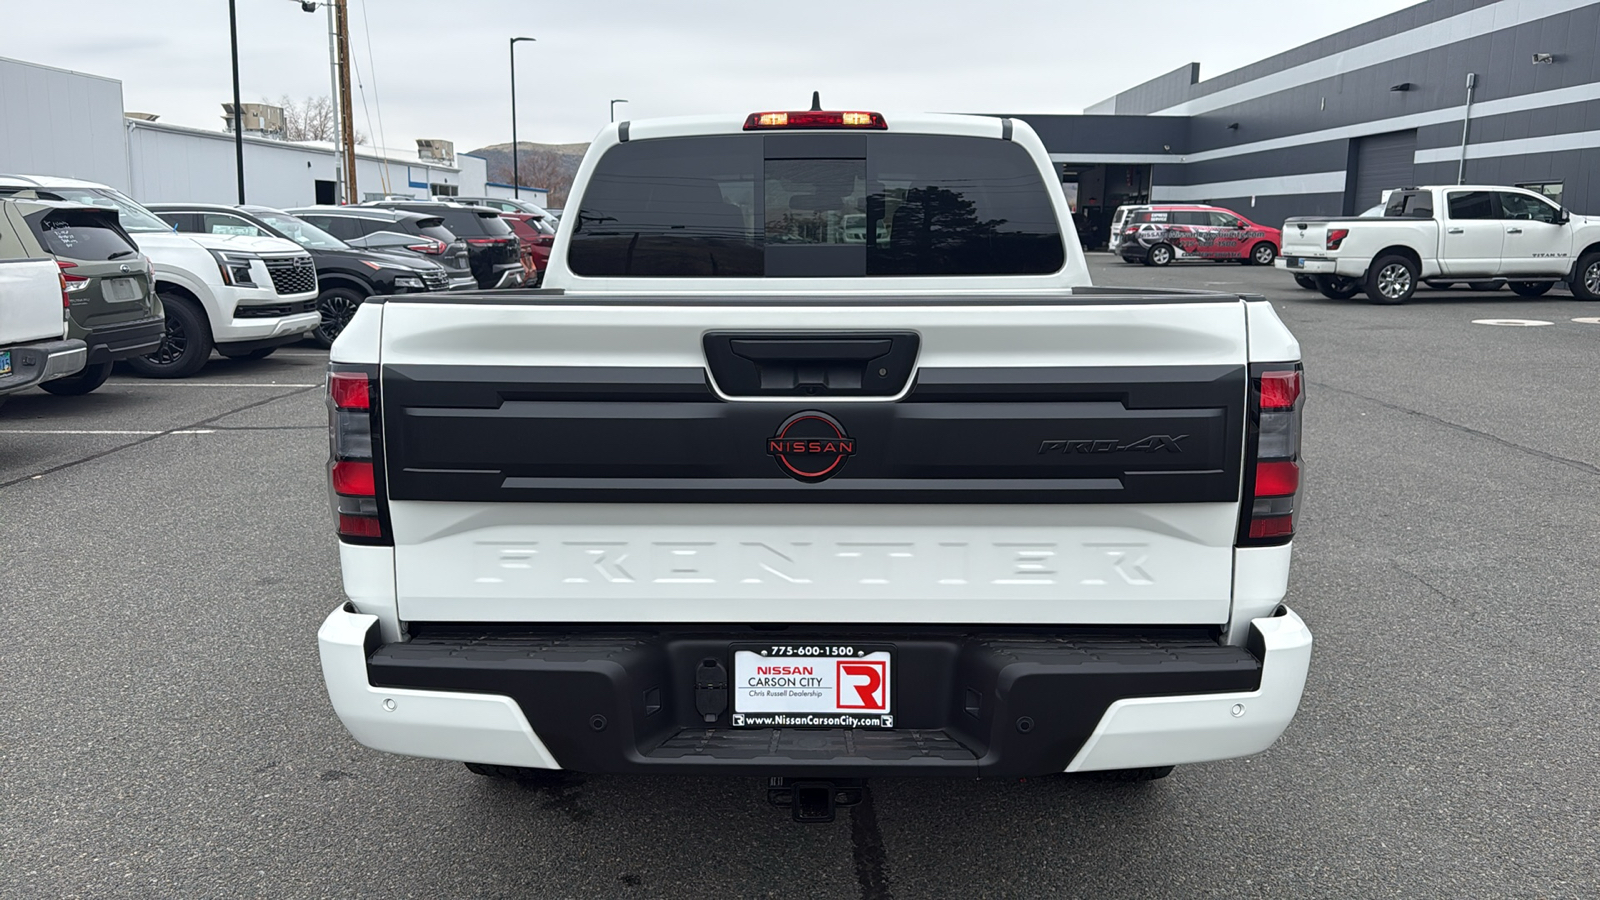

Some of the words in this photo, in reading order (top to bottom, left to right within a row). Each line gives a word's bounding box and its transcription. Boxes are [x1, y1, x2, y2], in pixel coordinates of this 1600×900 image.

[770, 441, 852, 452] NISSAN
[474, 541, 1155, 584] FRONTIER
[771, 646, 854, 656] 775-600-1500
[757, 666, 813, 675] NISSAN
[748, 677, 796, 687] CARSON
[799, 677, 823, 687] CITY
[789, 690, 823, 698] Dealership
[746, 715, 880, 728] www.NissanCarsonCity.com
